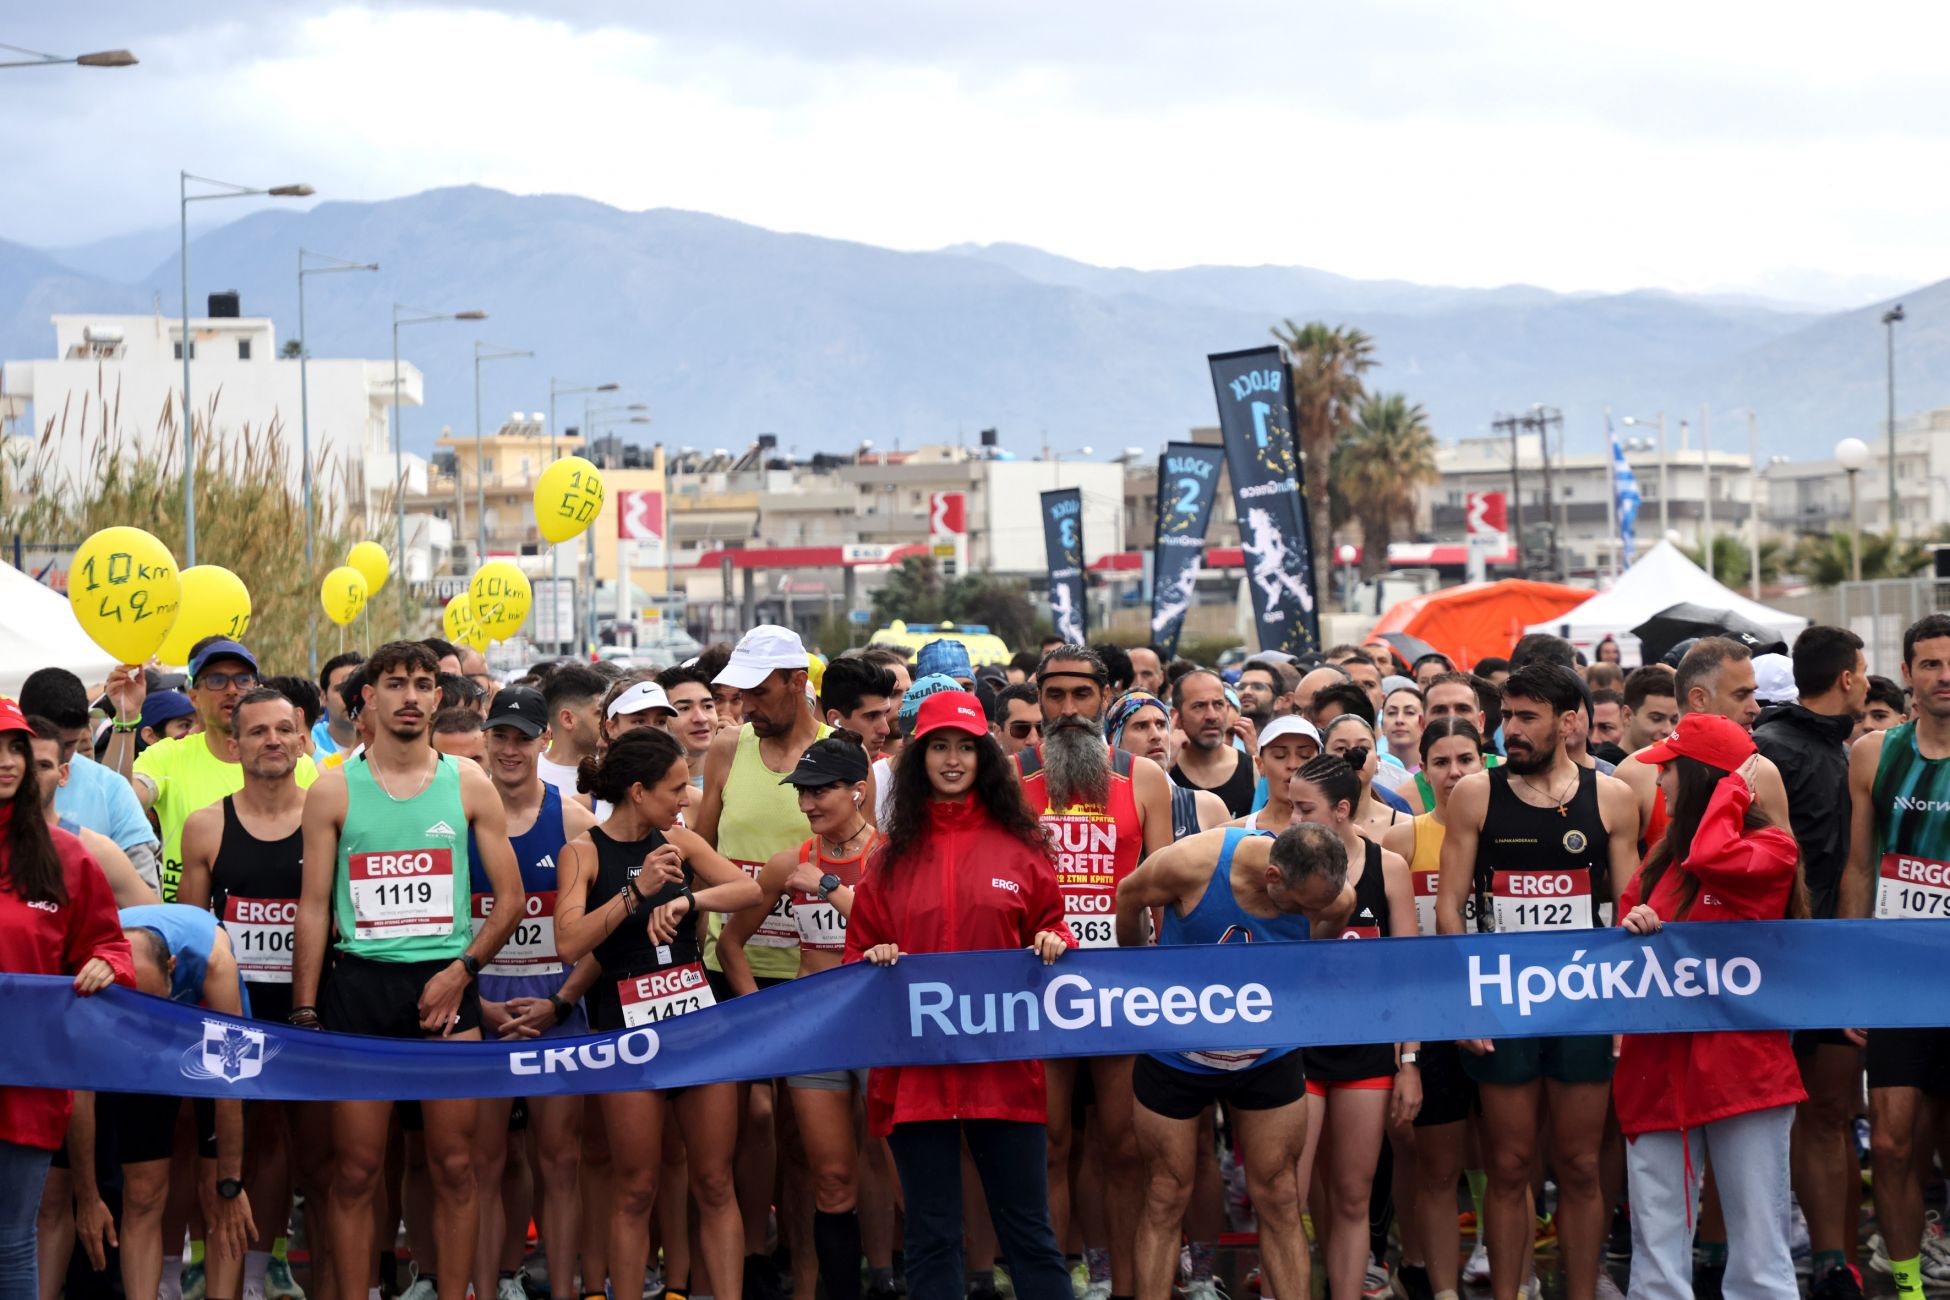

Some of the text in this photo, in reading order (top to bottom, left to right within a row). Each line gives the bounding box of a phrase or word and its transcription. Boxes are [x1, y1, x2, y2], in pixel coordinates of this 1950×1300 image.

[1167, 457, 1213, 480] BLOCK
[1175, 478, 1200, 513] 2
[957, 706, 976, 717] ERGO
[1042, 822, 1117, 853] RUN
[367, 853, 433, 876] ERGO
[1054, 853, 1115, 874] RETE
[992, 878, 1019, 894] ERGO
[1067, 875, 1088, 883] ΣΤΗΝ
[1090, 876, 1114, 884] ΚΡΗΤΗ
[1509, 875, 1573, 894] ERGO
[375, 882, 432, 905] 1119
[1065, 895, 1112, 912] RGO
[236, 902, 297, 923] ERGO
[481, 896, 542, 916] EO
[1515, 904, 1572, 925] 1122
[505, 925, 541, 945] 02
[1070, 922, 1112, 941] 363
[1469, 946, 1762, 1016] Ηράκλειο
[908, 974, 1273, 1037] RunGreece
[510, 1028, 660, 1075] ERGO
